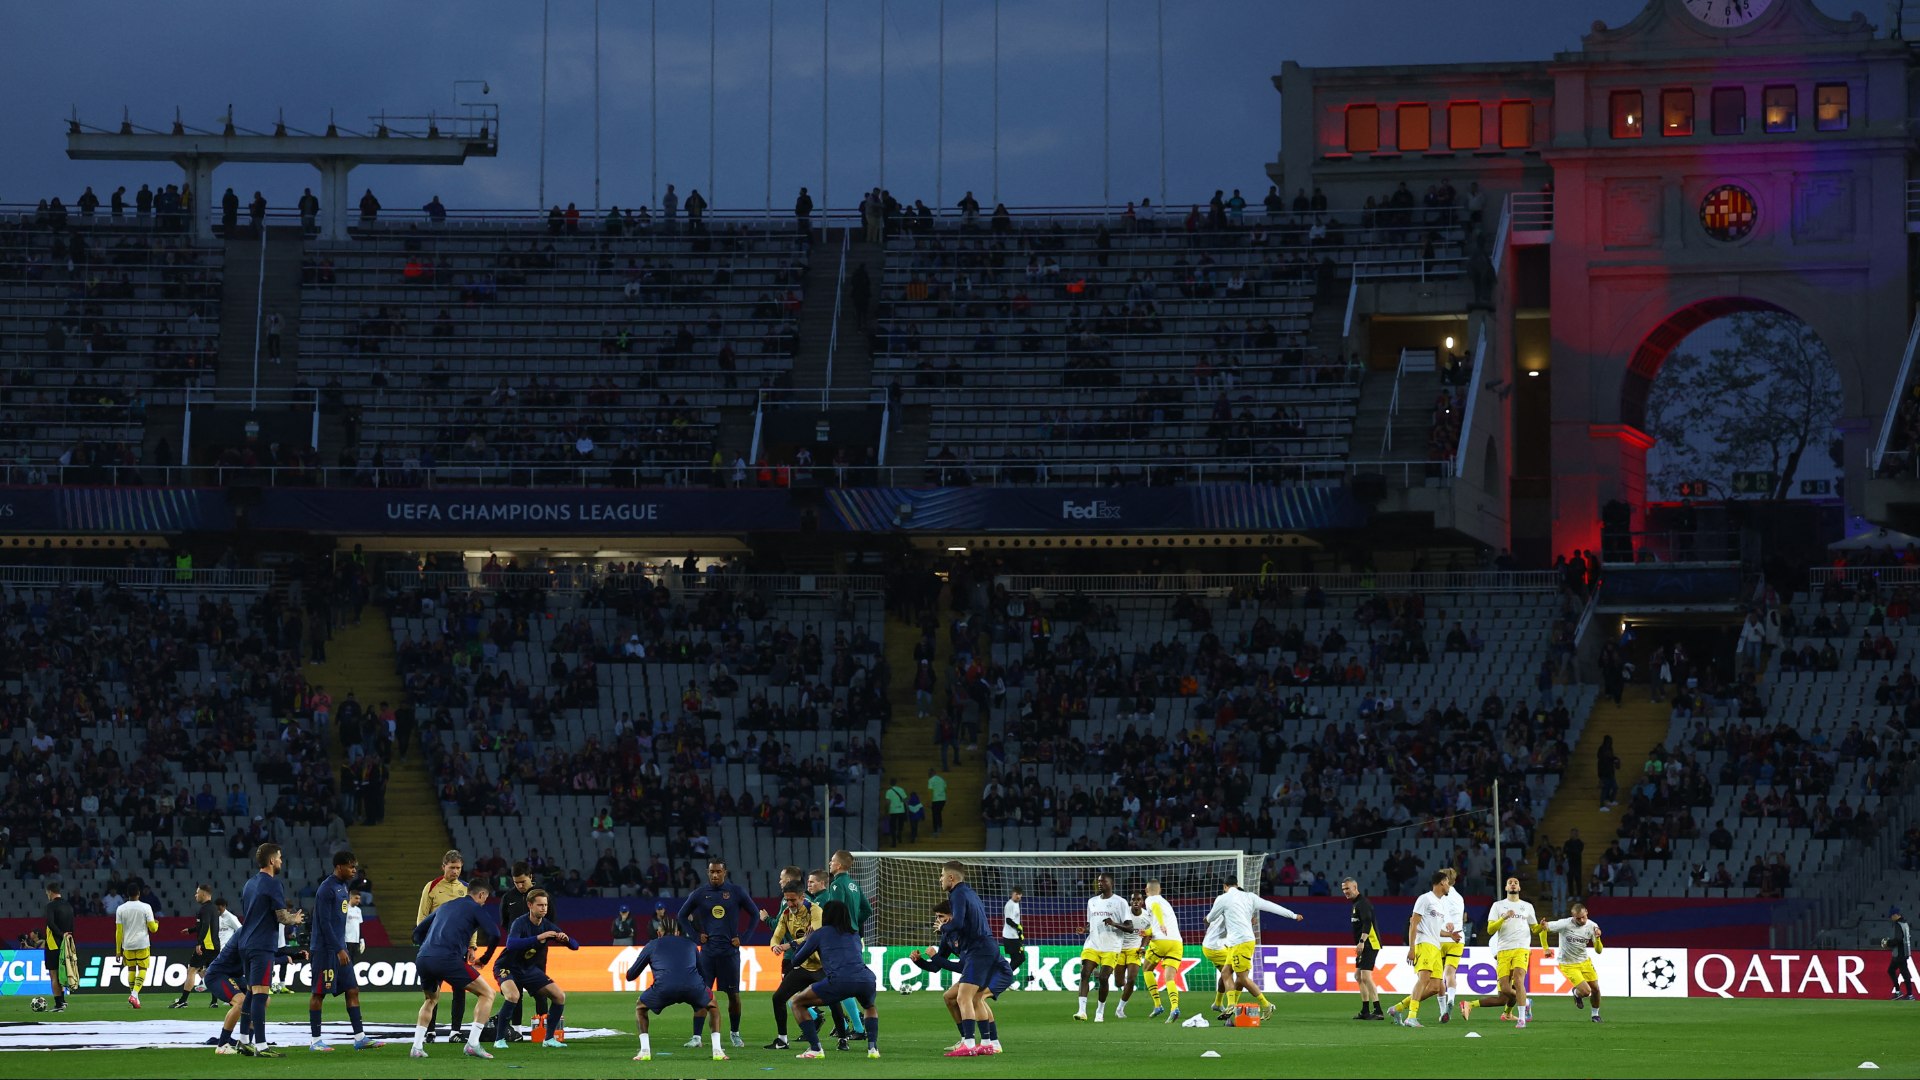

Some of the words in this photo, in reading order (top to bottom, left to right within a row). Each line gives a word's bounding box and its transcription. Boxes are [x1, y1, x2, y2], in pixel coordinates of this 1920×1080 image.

[1706, 1, 1712, 10] 7
[1743, 0, 1749, 9] 5
[1725, 6, 1731, 16] 6
[387, 503, 441, 520] UEFA
[447, 503, 571, 521] CHAMPIONS
[579, 503, 658, 520] LEAGUE
[1063, 500, 1121, 519] FedEx
[323, 969, 334, 981] 19
[1694, 953, 1868, 998] QATAR
